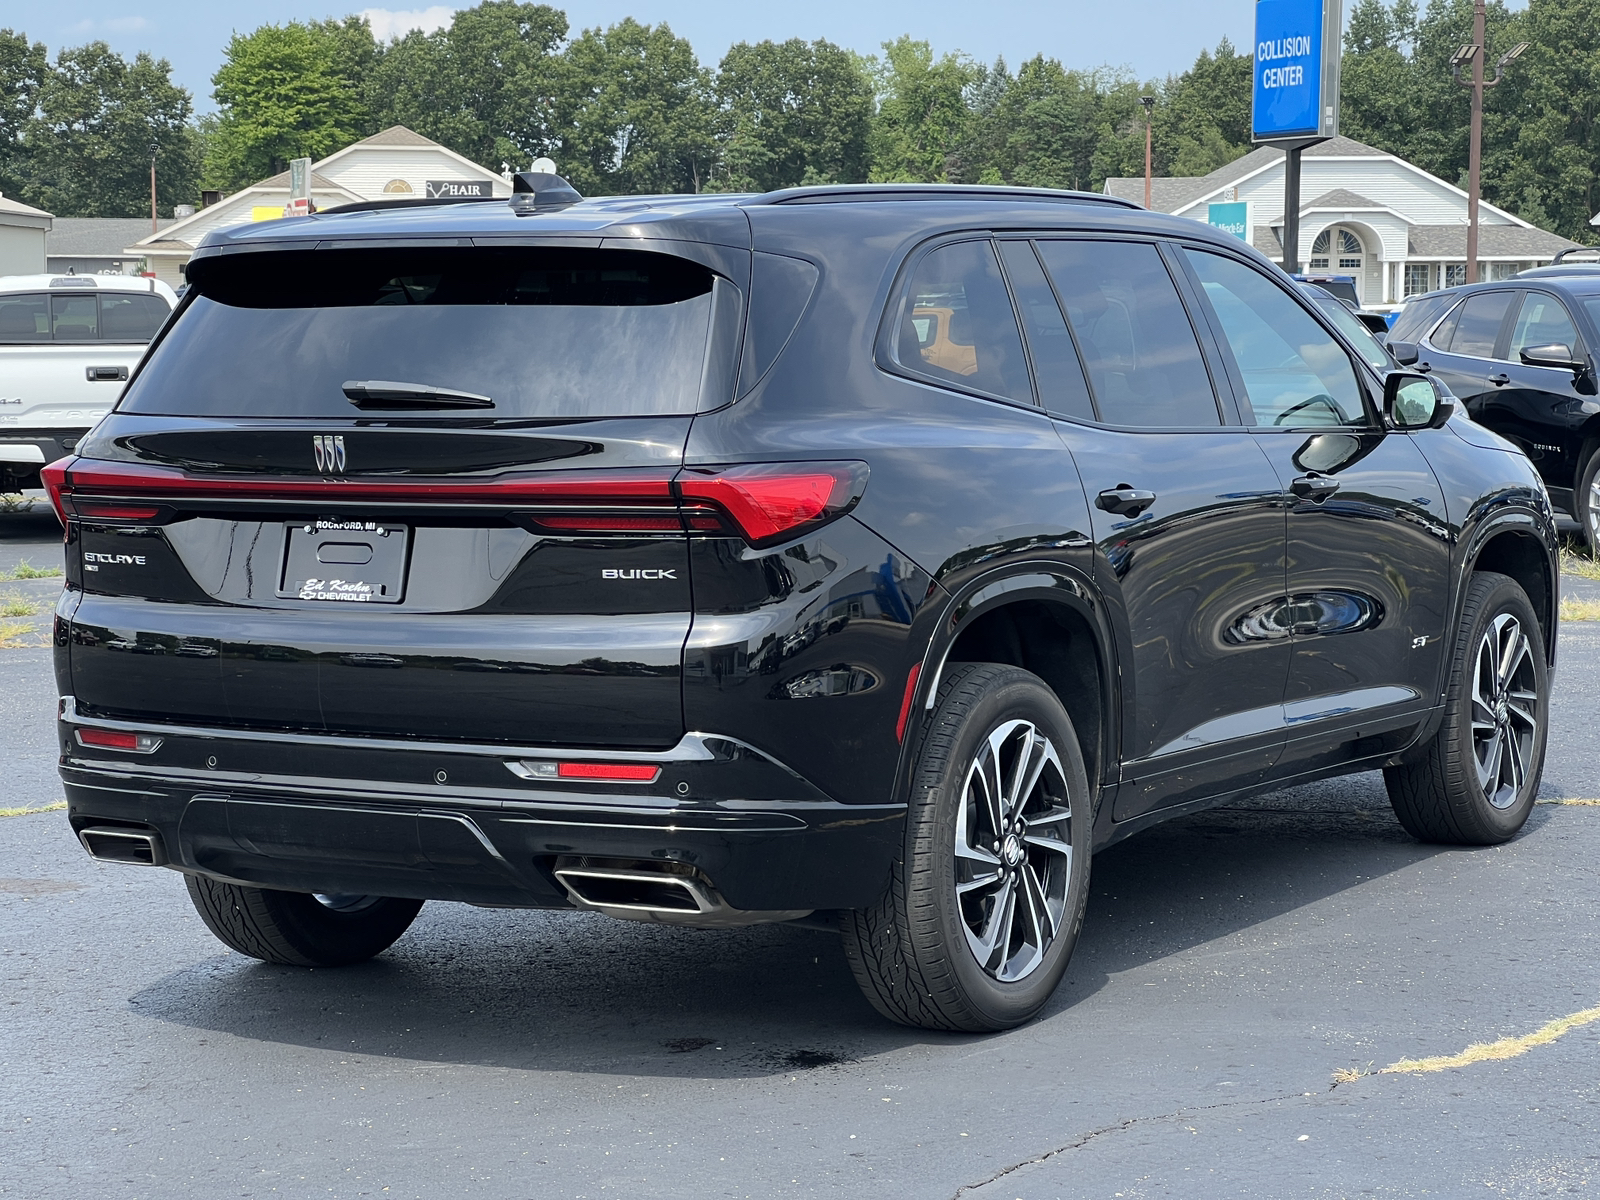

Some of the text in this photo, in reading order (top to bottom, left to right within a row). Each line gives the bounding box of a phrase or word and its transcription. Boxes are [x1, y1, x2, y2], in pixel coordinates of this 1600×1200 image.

[1257, 36, 1311, 62] COLLISION
[1263, 65, 1303, 89] CENTER
[449, 184, 482, 197] HAIR
[365, 522, 376, 531] MI
[84, 552, 147, 565] ENCLAVE
[601, 569, 678, 580] BUICK
[303, 578, 371, 593] Ed Koehn
[317, 592, 372, 602] CHEVROLET
